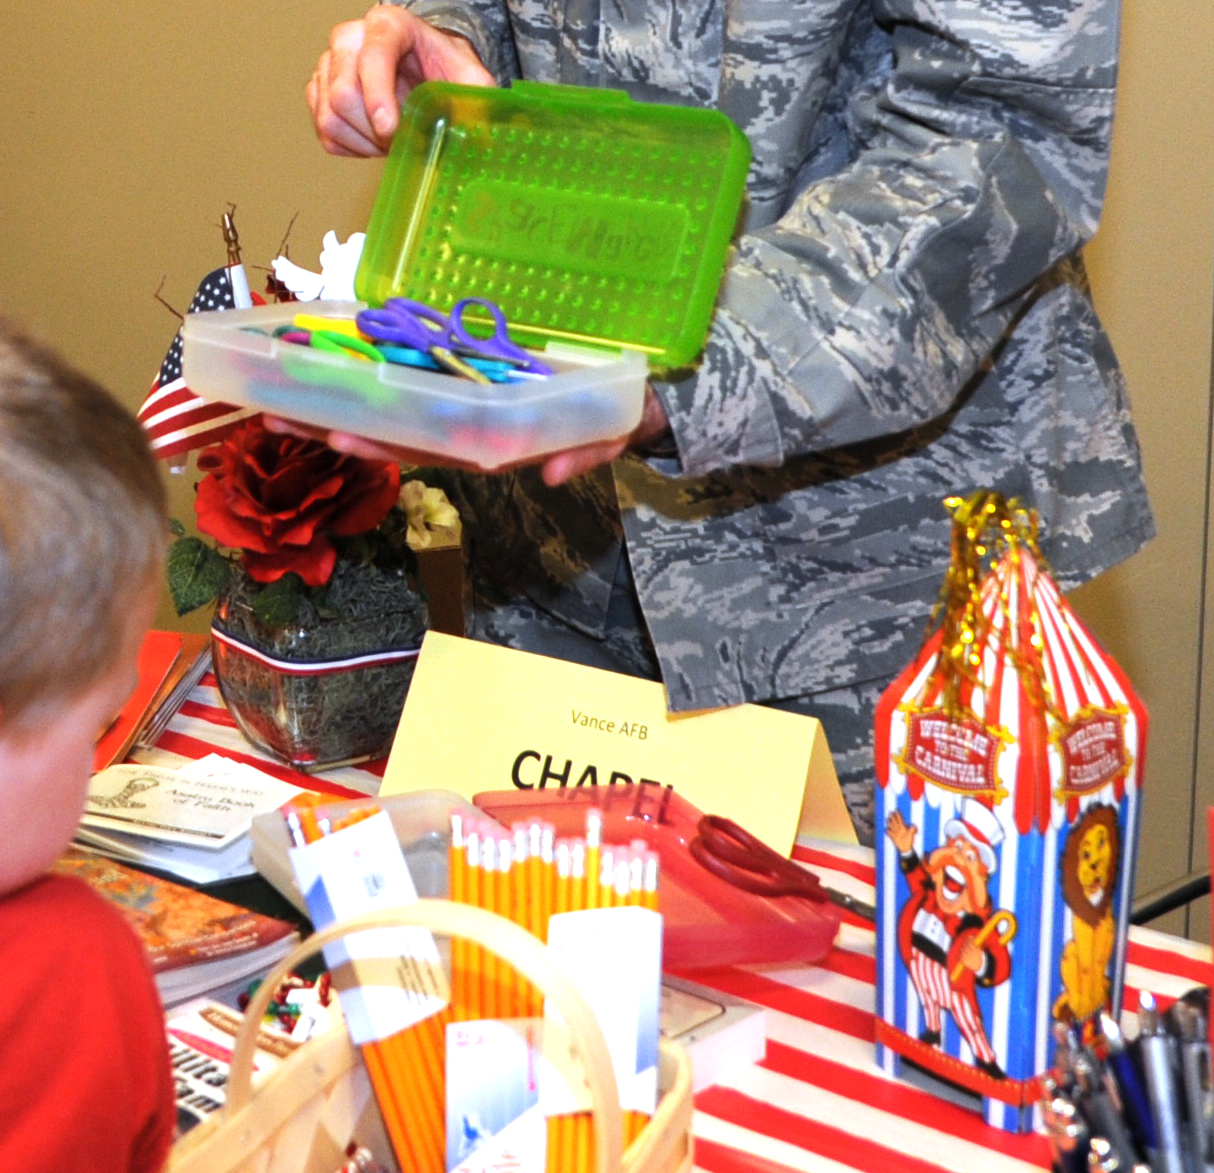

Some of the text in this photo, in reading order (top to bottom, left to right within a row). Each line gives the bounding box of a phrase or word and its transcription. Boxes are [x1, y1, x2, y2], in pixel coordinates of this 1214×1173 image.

[571, 709, 649, 740] Vance AFB
[915, 744, 986, 784] CARNIVAL
[511, 749, 676, 828] CHAPEL
